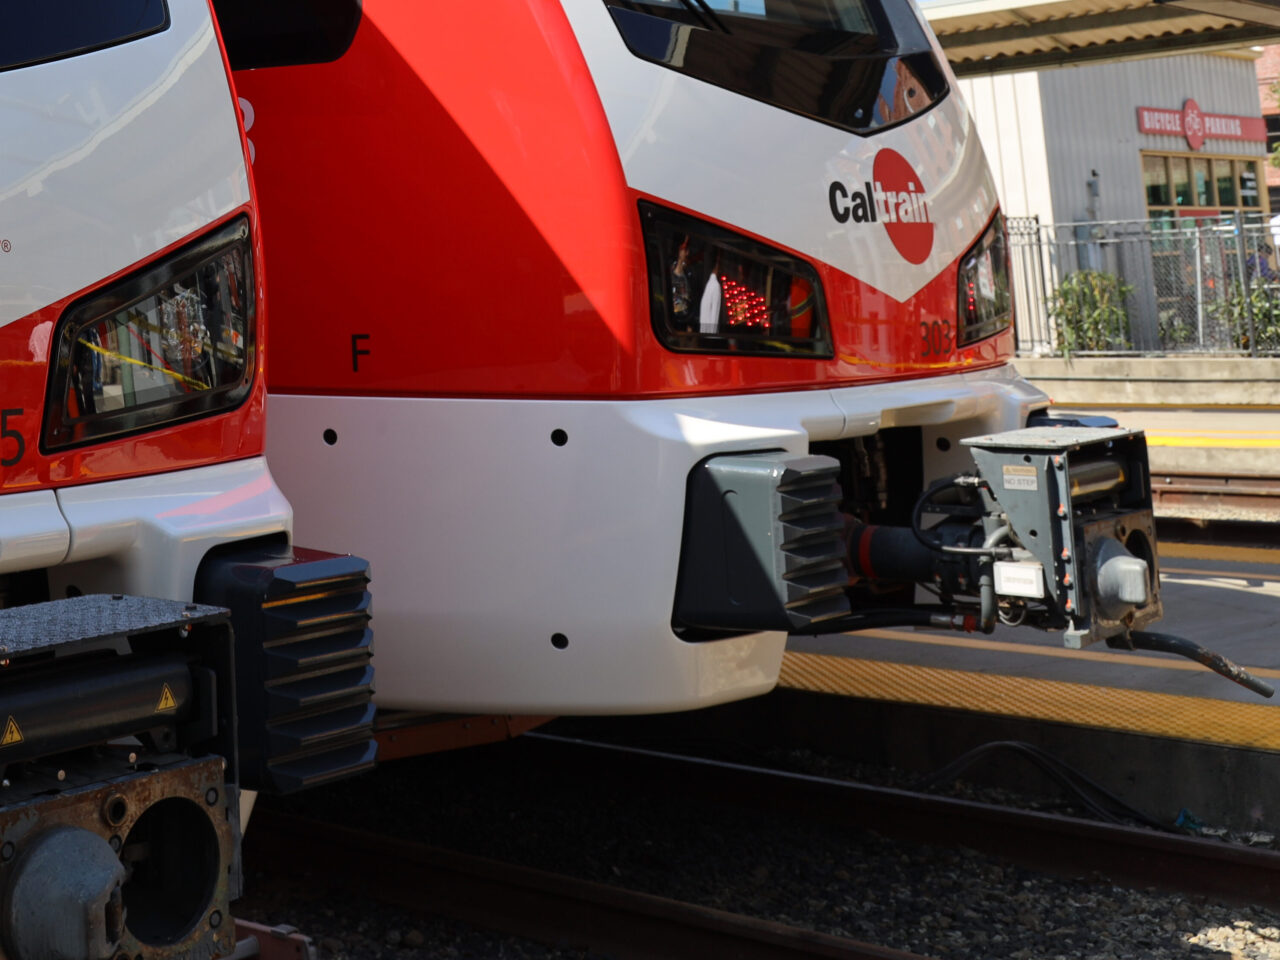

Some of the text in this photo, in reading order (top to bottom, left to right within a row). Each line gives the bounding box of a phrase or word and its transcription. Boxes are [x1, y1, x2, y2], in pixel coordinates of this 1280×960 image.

[1143, 111, 1242, 136] BICYCLE PARKING
[828, 180, 934, 224] Caltrain
[351, 334, 370, 373] F
[920, 320, 952, 357] 303
